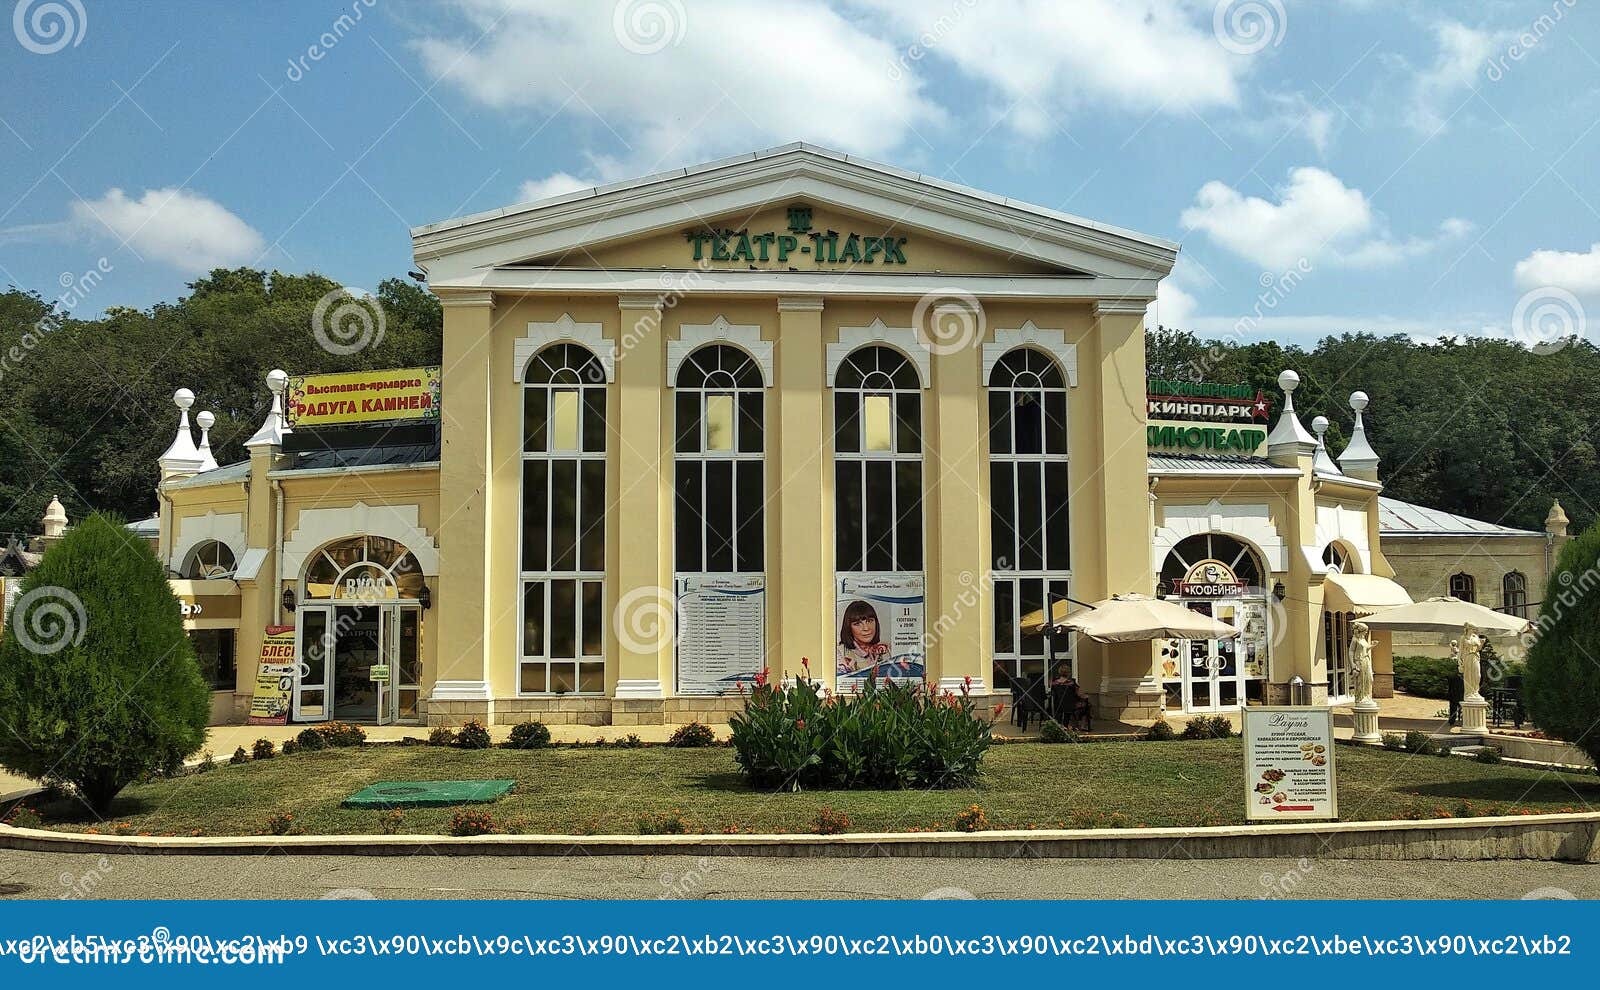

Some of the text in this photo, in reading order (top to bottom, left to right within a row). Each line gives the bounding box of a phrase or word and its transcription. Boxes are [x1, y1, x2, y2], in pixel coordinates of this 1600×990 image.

[688, 233, 908, 264] ТЕАТР-ПАРК
[307, 378, 421, 395] Выставка-ярмарка
[297, 392, 432, 417] РАДУГА КАМНЕЙ
[1149, 401, 1252, 417] КИНОПАРК
[346, 578, 386, 596] ВХОД
[1190, 584, 1237, 595] КОФЕЙНЯ
[263, 665, 269, 673] 2
